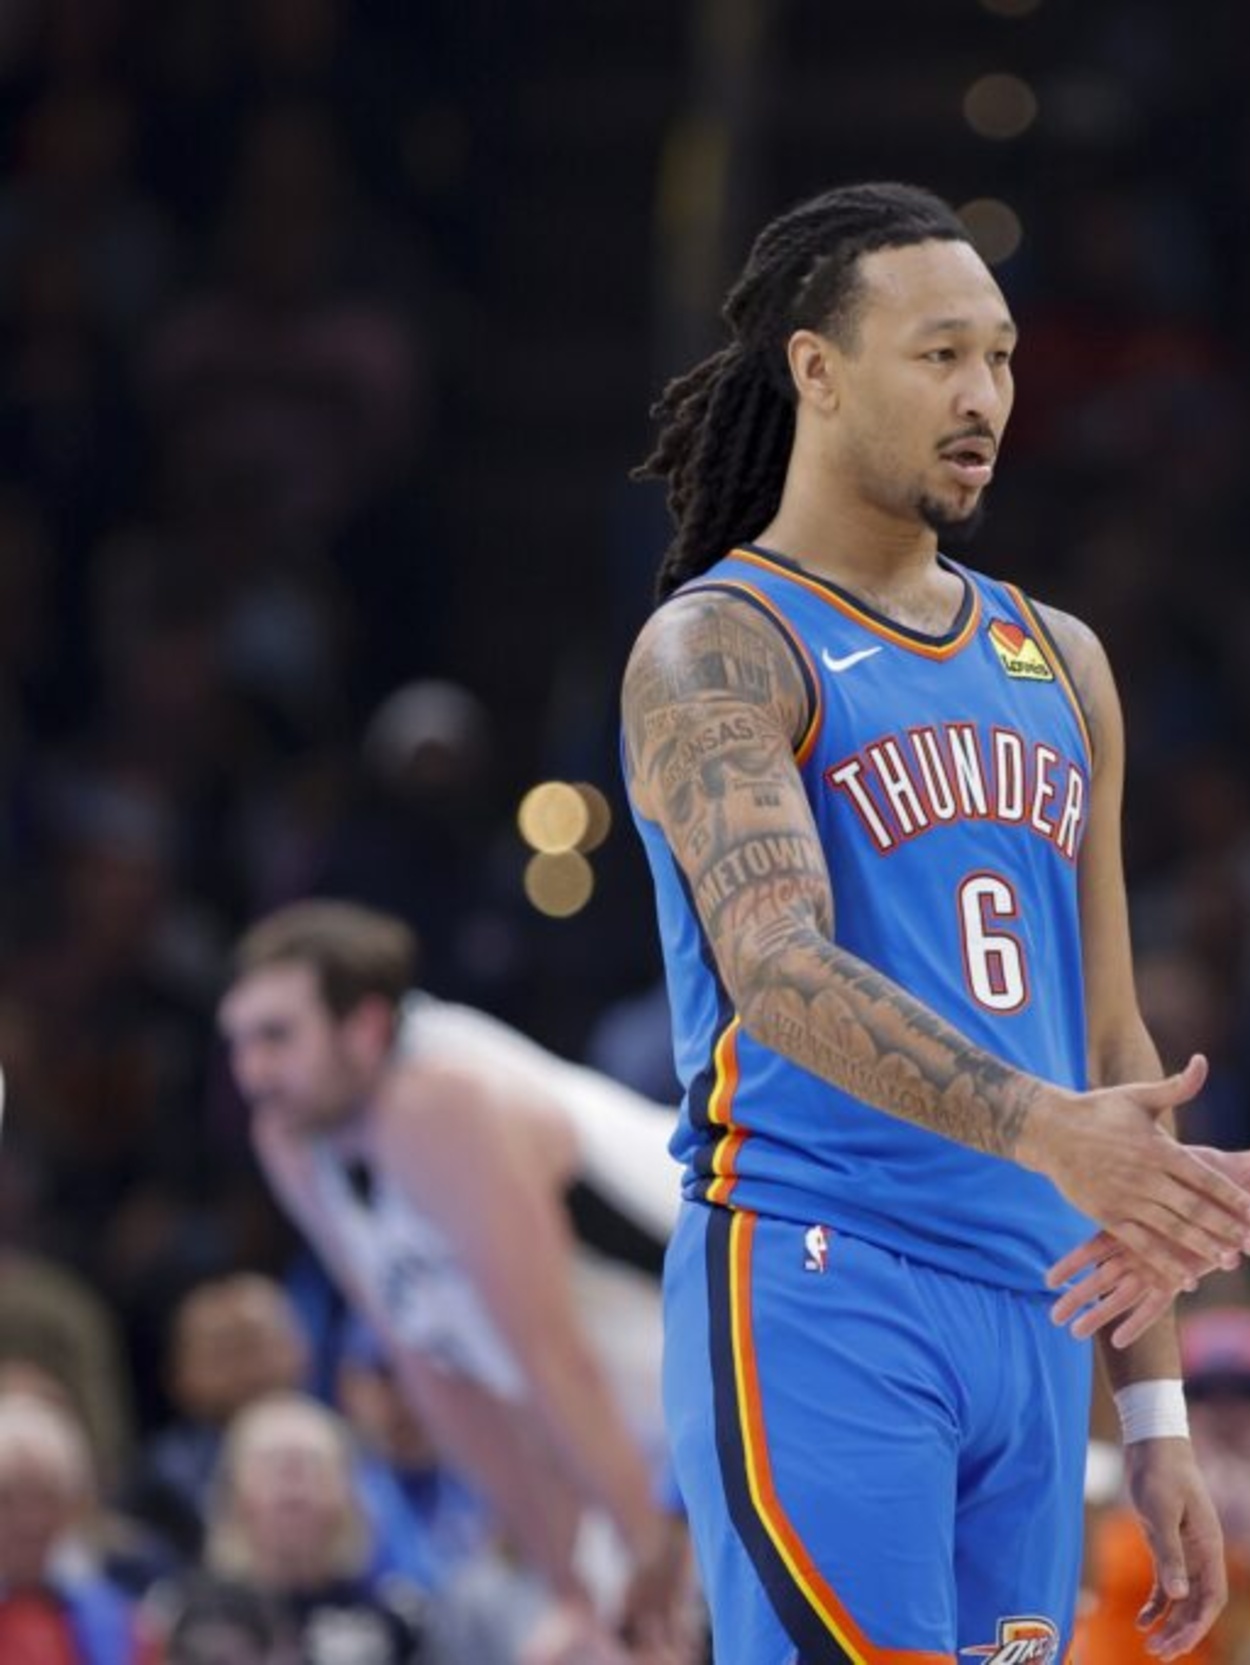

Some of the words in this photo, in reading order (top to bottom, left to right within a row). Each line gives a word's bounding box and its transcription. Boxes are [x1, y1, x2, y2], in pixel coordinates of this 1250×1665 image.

[826, 723, 1091, 866] THUNDER
[697, 836, 823, 919] METOWN
[957, 868, 1029, 1014] 6
